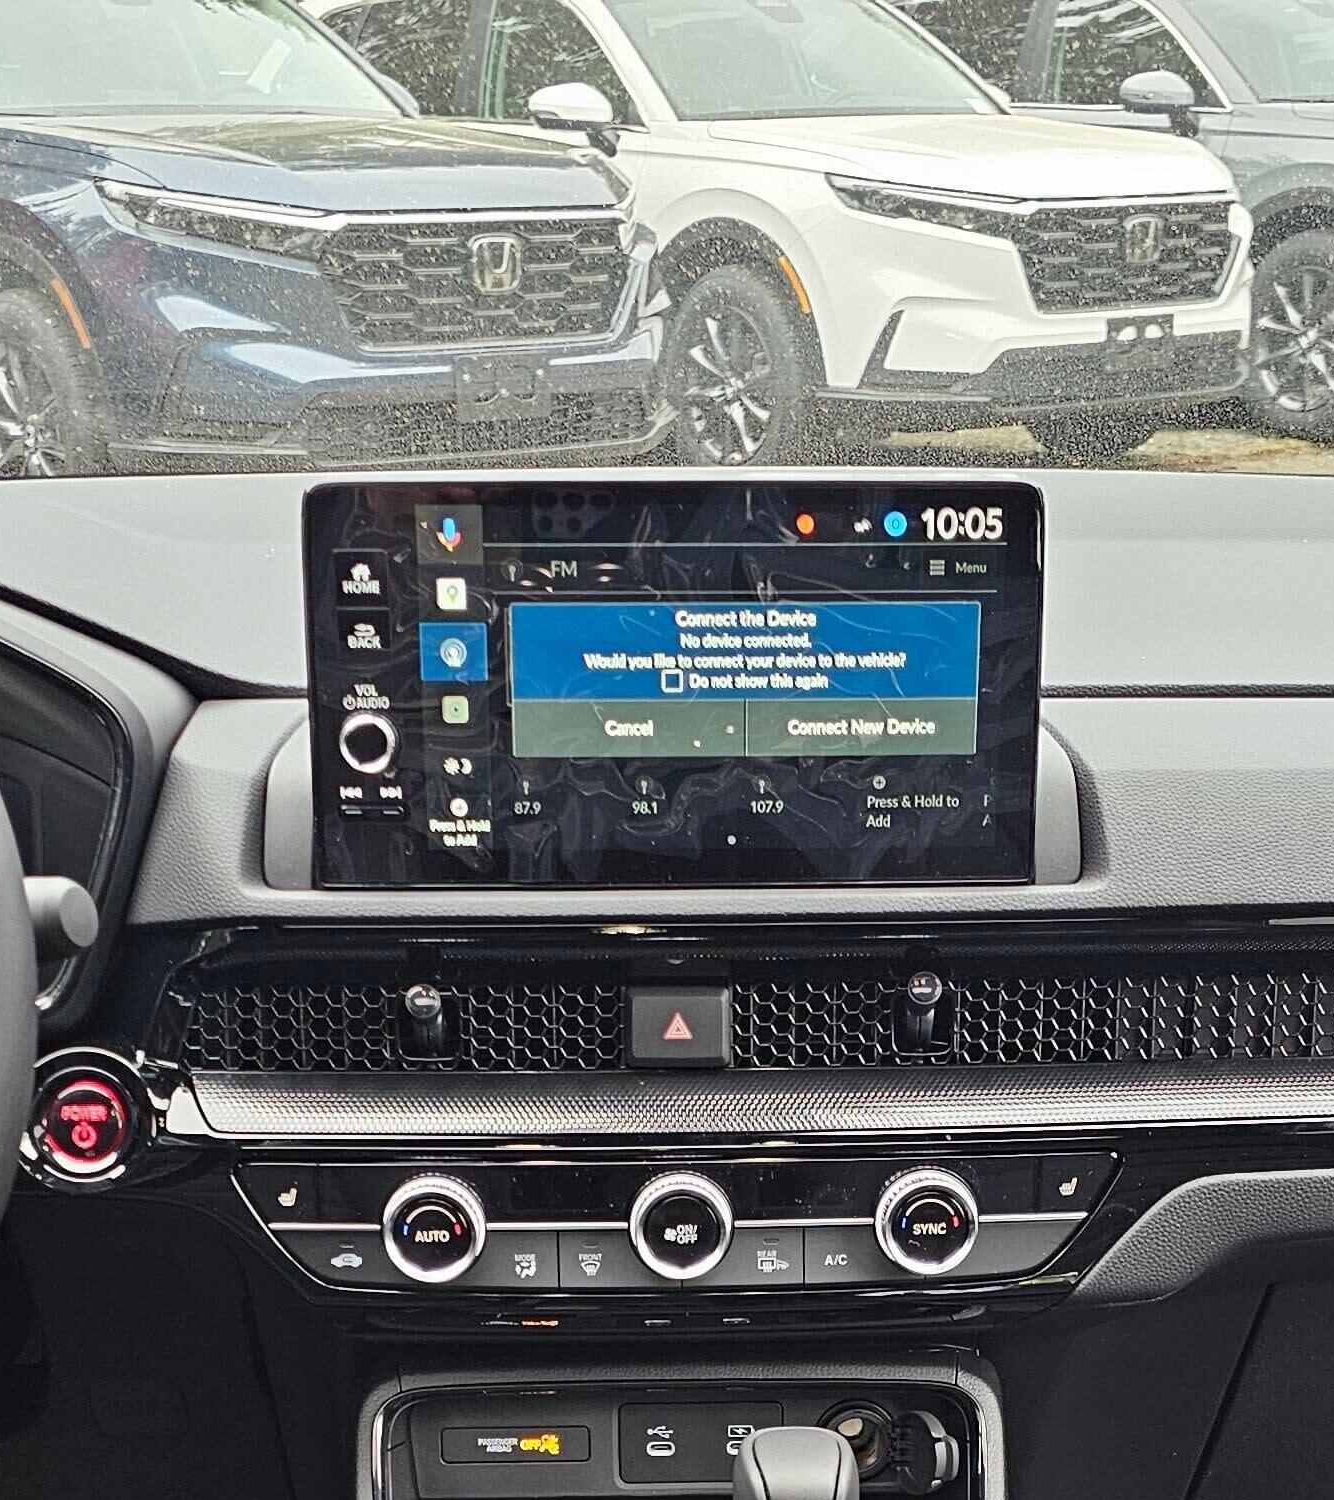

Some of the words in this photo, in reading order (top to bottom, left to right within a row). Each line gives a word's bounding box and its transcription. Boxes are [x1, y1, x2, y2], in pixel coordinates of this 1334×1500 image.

[921, 507, 1004, 540] 10:05
[550, 561, 577, 577] FM
[955, 561, 987, 575] Menu
[341, 580, 381, 595] HOME
[675, 610, 738, 627] Connect
[740, 610, 765, 627] the
[767, 610, 817, 627] Device
[347, 635, 382, 649] BACK
[680, 633, 701, 649] No
[702, 633, 742, 649] device
[743, 633, 812, 649] connected.
[583, 653, 627, 669] Would
[627, 655, 652, 671] you
[653, 652, 677, 669] like
[677, 654, 692, 669] to
[694, 654, 745, 669] connect
[745, 655, 774, 671] your
[776, 653, 816, 668] device
[818, 653, 832, 668] to
[834, 652, 856, 668] the
[857, 651, 907, 668] vehicle?
[689, 673, 710, 689] Do
[711, 674, 733, 689] not
[734, 673, 768, 689] show
[770, 672, 793, 689] this
[795, 672, 829, 691] again
[354, 684, 378, 697] VOL
[355, 697, 390, 710] AUDIO
[604, 719, 654, 738] Cancel
[787, 719, 847, 736] Connect
[851, 719, 884, 736] New
[887, 718, 935, 735] Device
[514, 801, 541, 815] 87.9
[632, 801, 658, 815] 98.1
[750, 801, 784, 815] 107.9
[867, 795, 898, 808] Press
[901, 795, 912, 808] &
[914, 794, 943, 808] Hold
[946, 795, 960, 808] to
[429, 819, 456, 832] Press
[456, 820, 467, 832] &
[467, 819, 491, 832] Hold
[866, 814, 891, 828] Add
[443, 835, 455, 847] to
[456, 834, 478, 847] Add
[912, 1222, 947, 1235] SYNC
[414, 1230, 450, 1243] AUTO
[676, 1233, 698, 1245] OFF
[514, 1253, 536, 1261] MODE
[578, 1253, 603, 1261] FRONT
[824, 1254, 848, 1266] A/C
